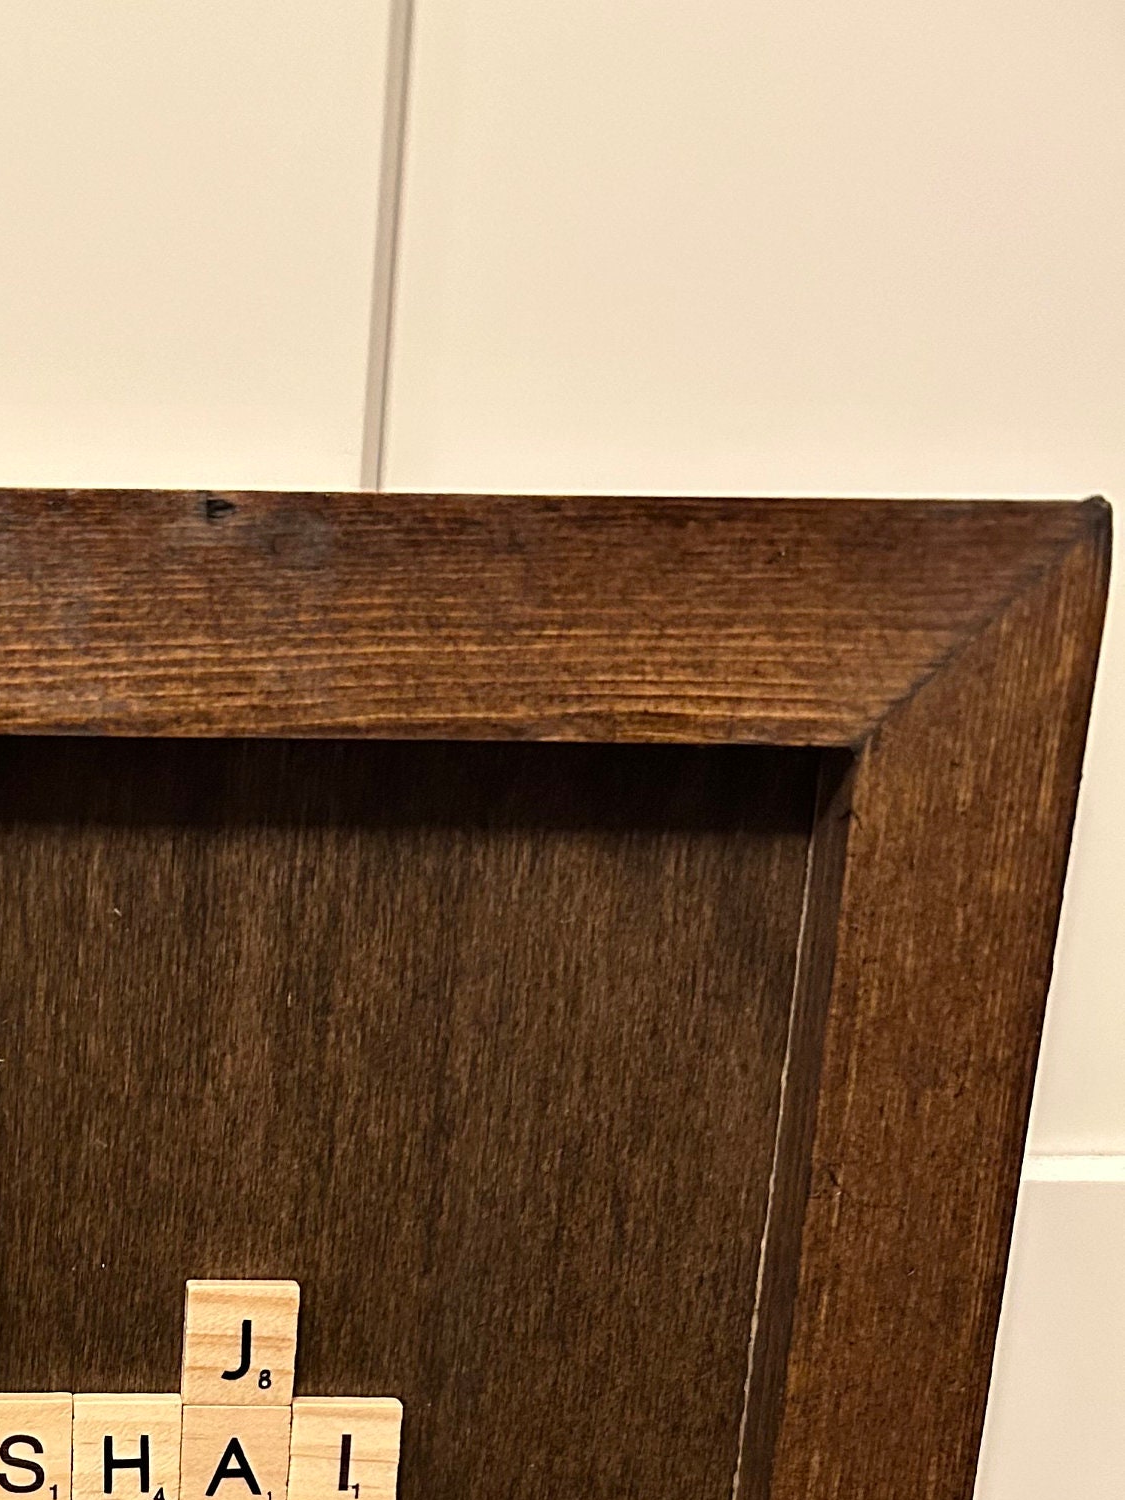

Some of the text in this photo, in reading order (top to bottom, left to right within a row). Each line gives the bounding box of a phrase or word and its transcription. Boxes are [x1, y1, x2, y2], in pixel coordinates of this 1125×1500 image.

[258, 1369, 272, 1390] 8
[49, 1484, 58, 1500] 1
[351, 1483, 360, 1500] 1
